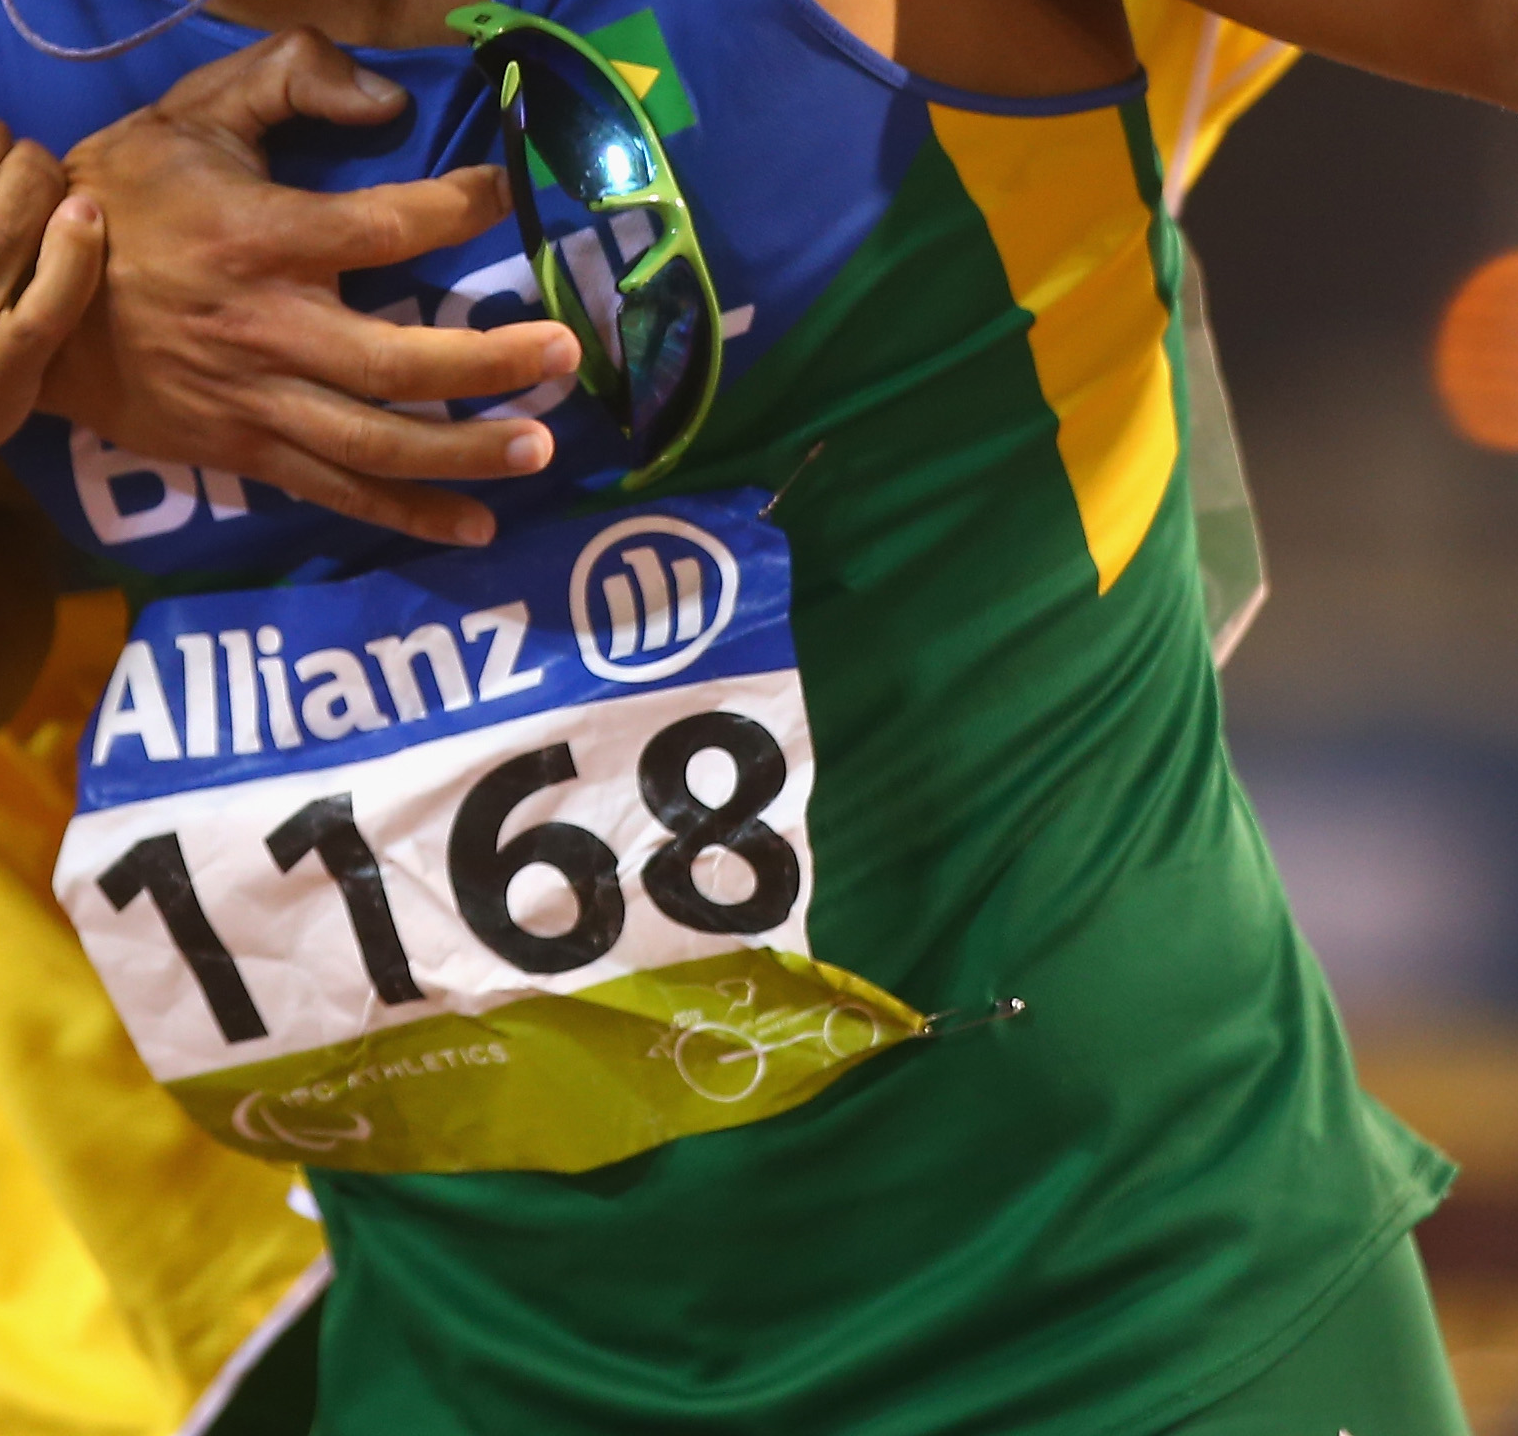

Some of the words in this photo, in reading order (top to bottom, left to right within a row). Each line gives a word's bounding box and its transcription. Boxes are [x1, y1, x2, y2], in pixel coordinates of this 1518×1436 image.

[91, 600, 545, 766] Allianz
[97, 710, 801, 1047] 1168
[346, 1042, 510, 1090] ATHLETICS
